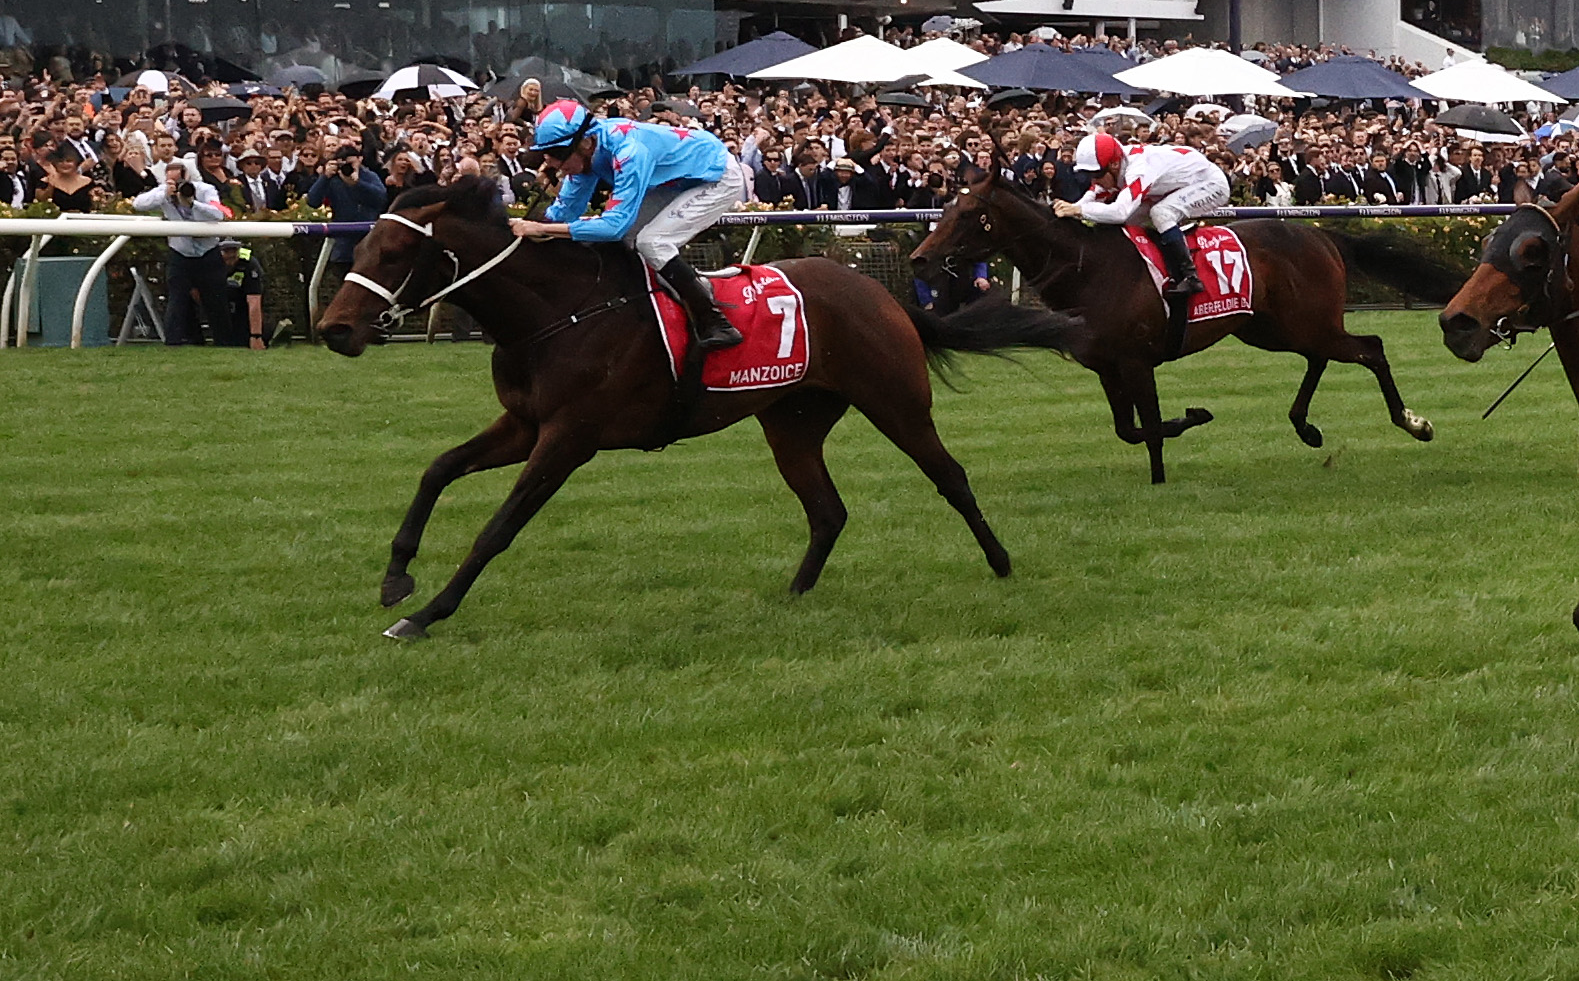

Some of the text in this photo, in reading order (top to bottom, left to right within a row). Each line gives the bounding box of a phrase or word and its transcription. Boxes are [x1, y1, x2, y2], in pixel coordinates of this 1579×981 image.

[1205, 250, 1245, 295] 17
[1193, 298, 1240, 316] ABERFELDIE
[766, 295, 797, 358] 7
[729, 362, 804, 385] MANZOICE
